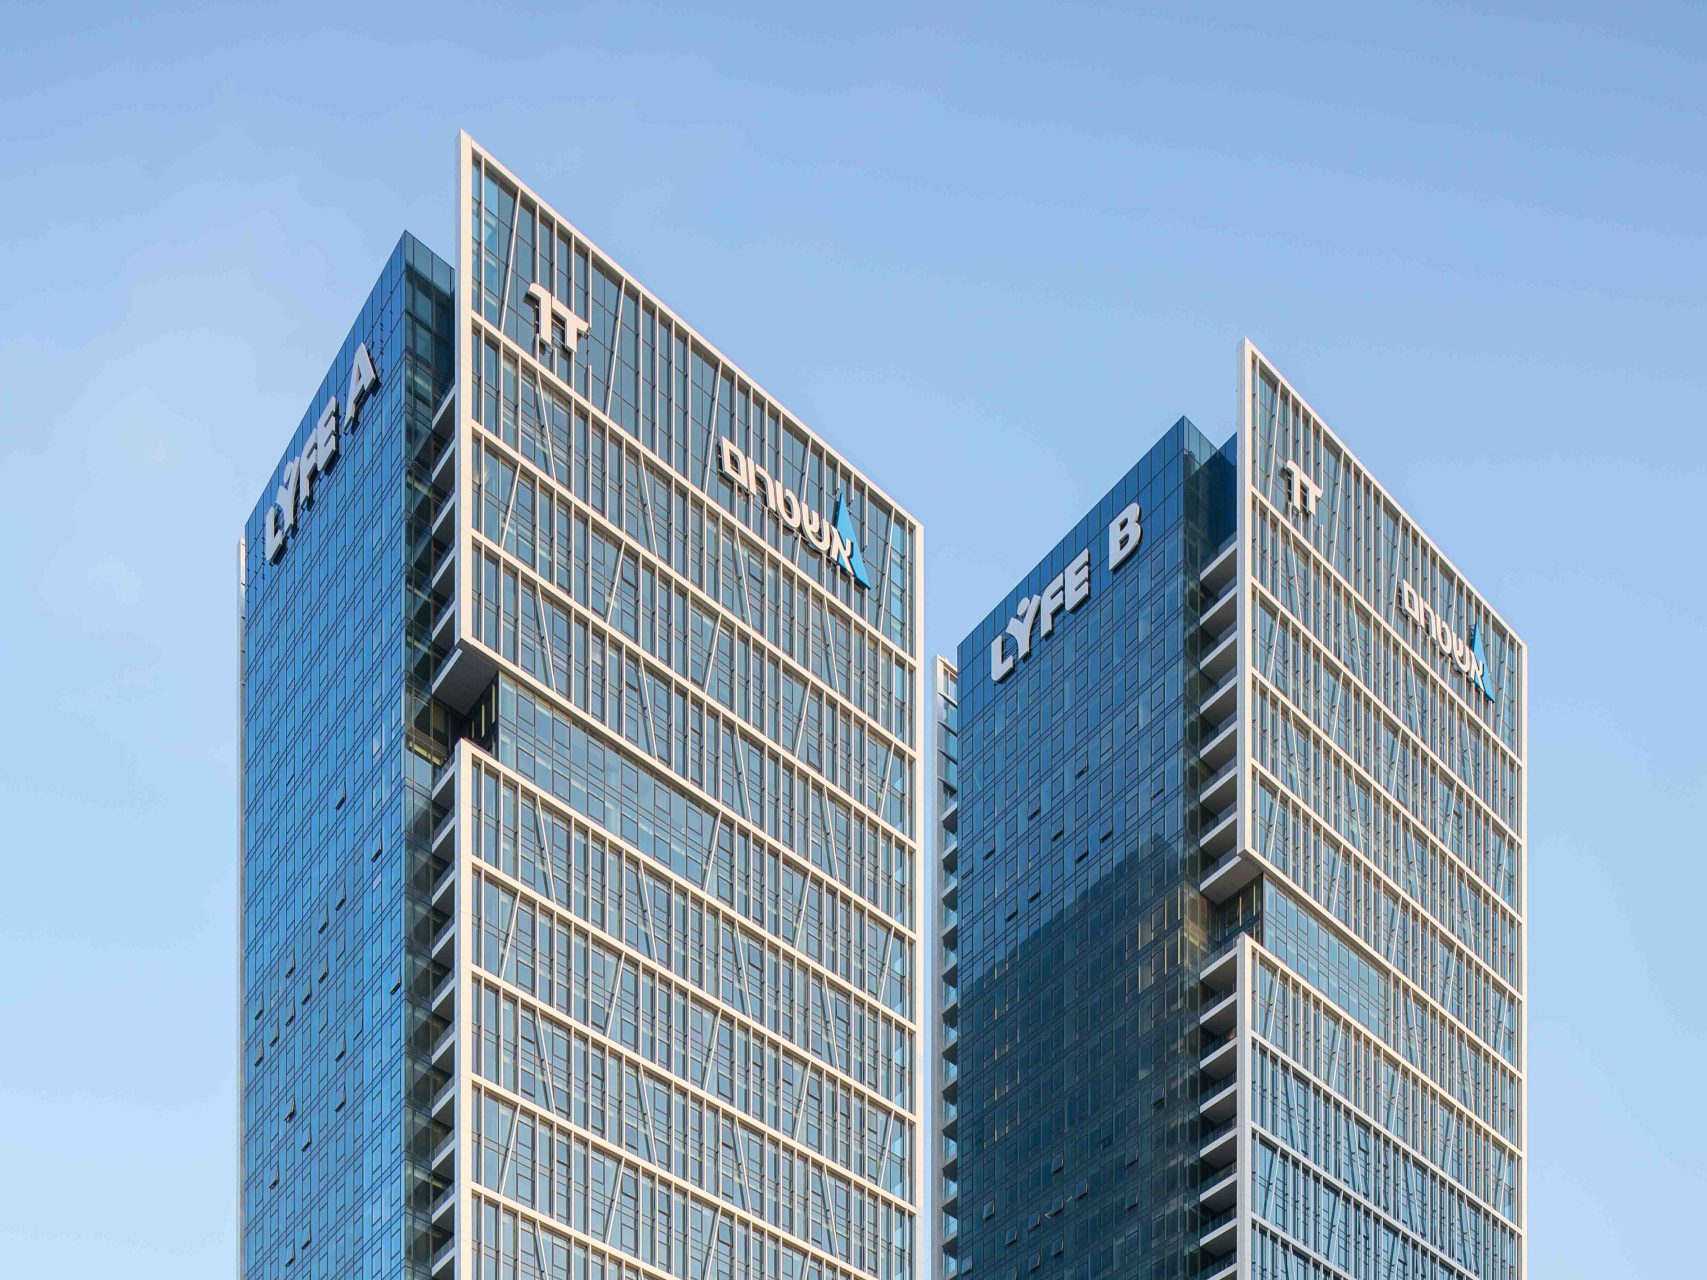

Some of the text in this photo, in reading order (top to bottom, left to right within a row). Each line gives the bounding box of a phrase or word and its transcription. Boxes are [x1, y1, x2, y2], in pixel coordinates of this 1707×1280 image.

[265, 342, 377, 563] LYFE A
[720, 436, 854, 577] אשטרום
[991, 502, 1142, 682] LYFE B
[1402, 579, 1486, 692] אשטרום
